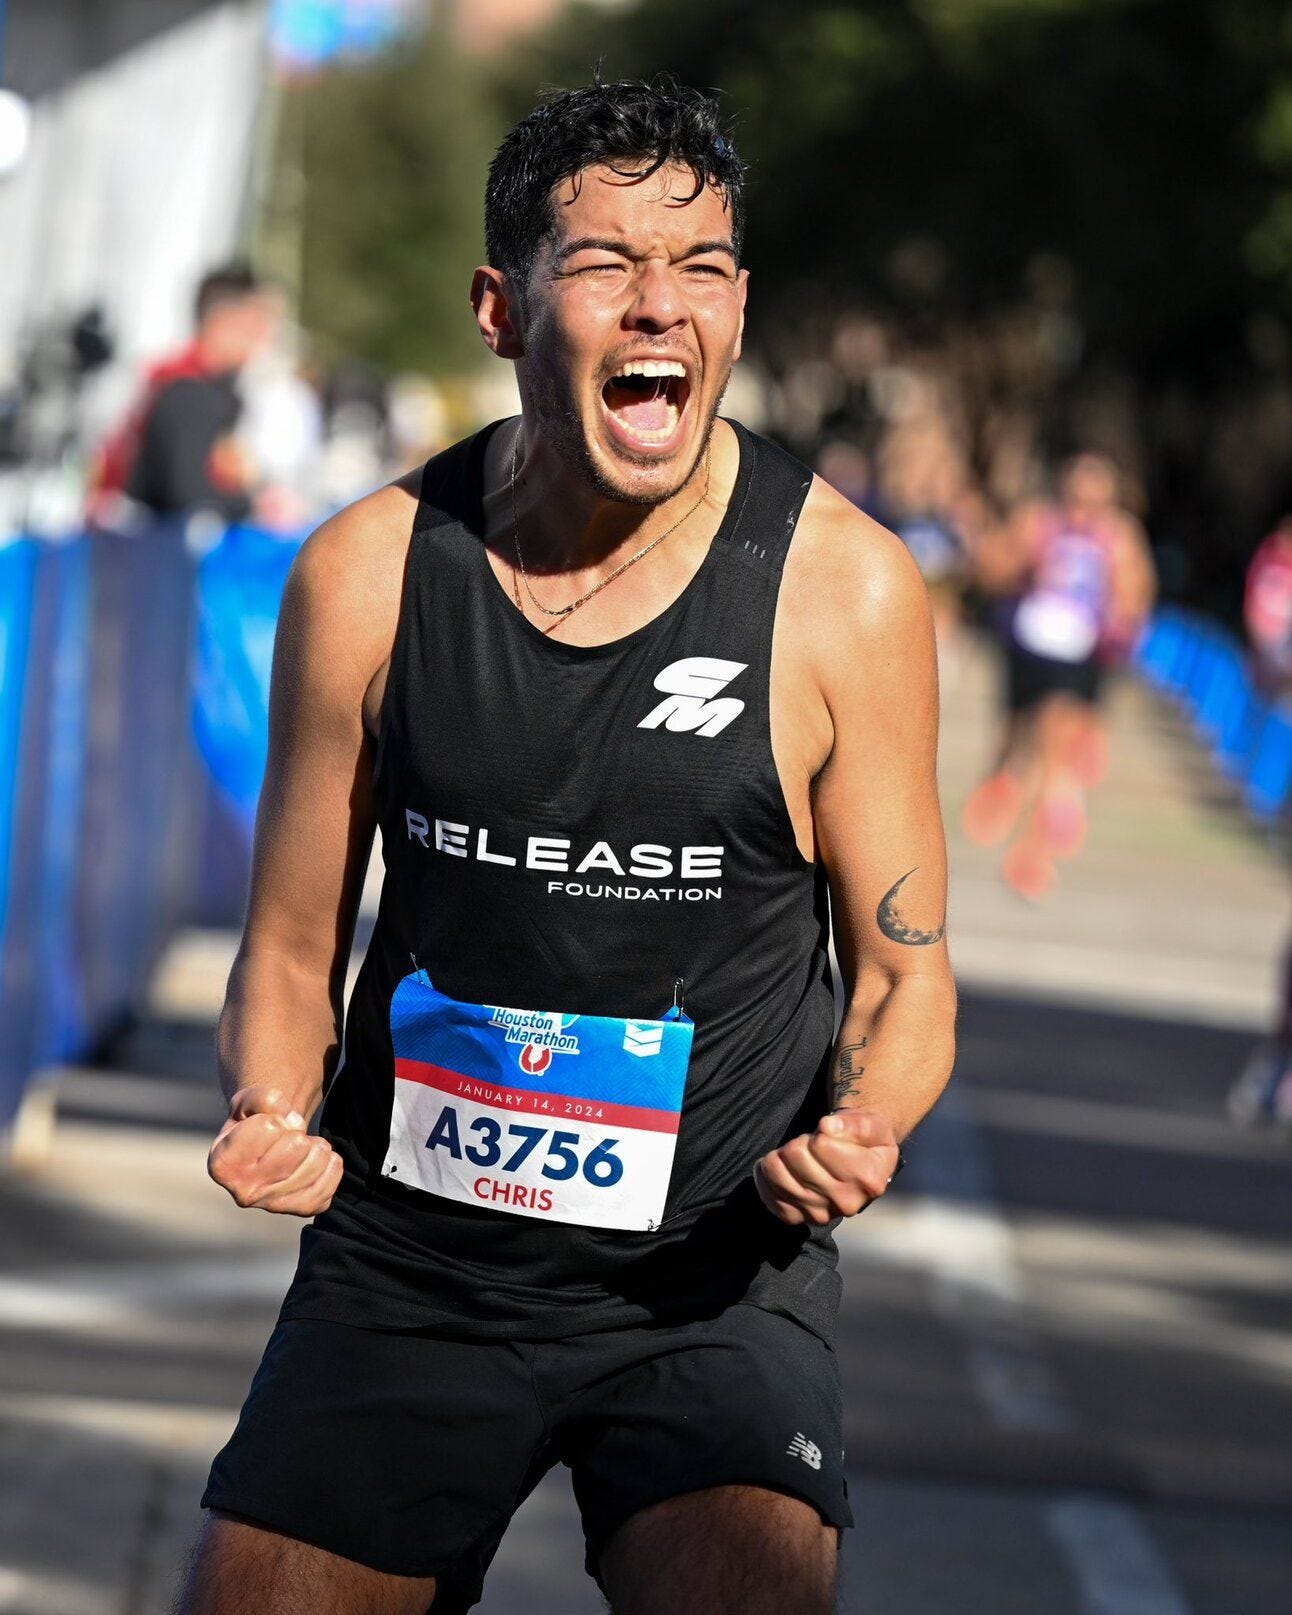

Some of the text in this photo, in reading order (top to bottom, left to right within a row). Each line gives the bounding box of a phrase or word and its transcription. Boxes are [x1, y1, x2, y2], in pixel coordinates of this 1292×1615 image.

[405, 808, 725, 879] RELEASE
[547, 881, 722, 901] FOUNDATION
[494, 1008, 553, 1030] Houston
[507, 1027, 576, 1050] Marathon
[457, 1081, 604, 1118] JANUARY 14, 2024
[425, 1105, 624, 1187] A3756
[473, 1177, 553, 1211] CHRIS
